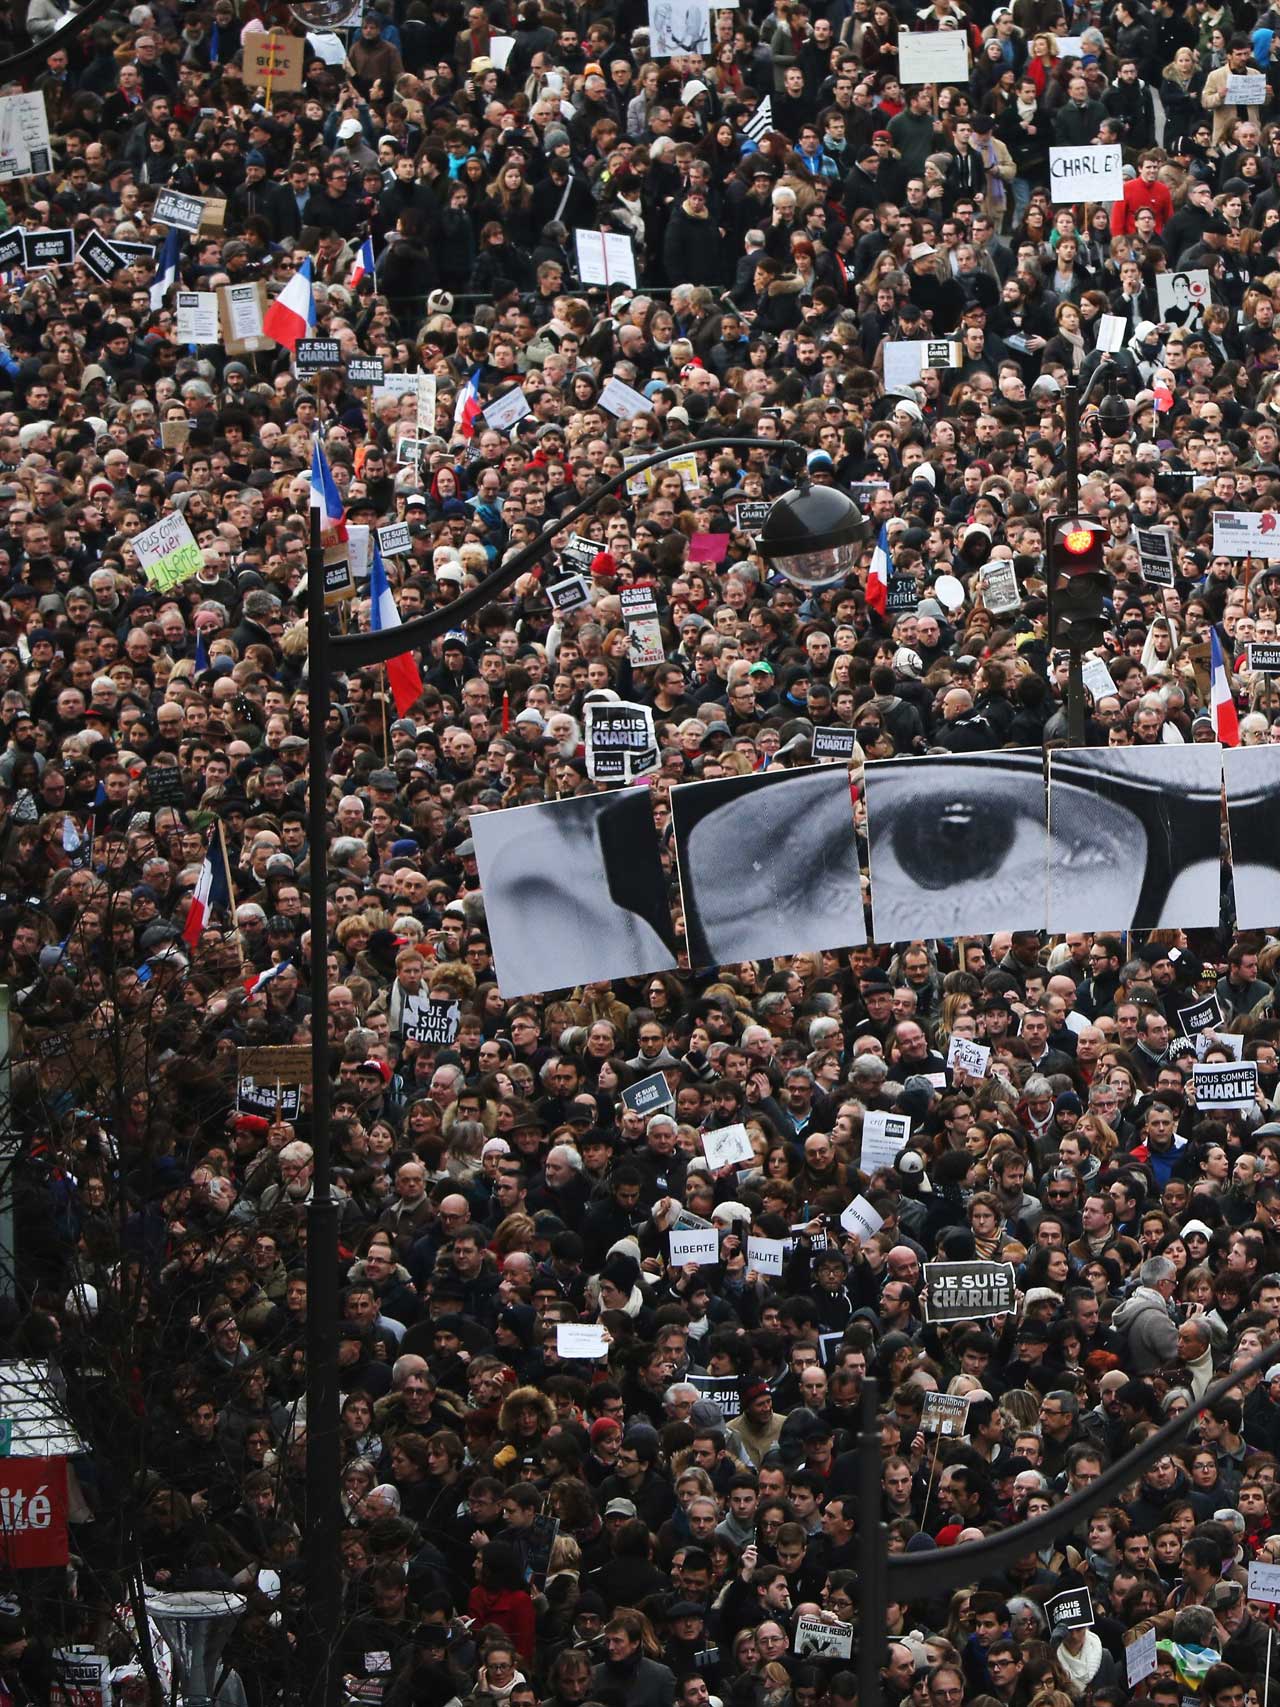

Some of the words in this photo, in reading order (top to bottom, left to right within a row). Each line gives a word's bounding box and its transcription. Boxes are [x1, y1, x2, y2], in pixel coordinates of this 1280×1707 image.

[161, 195, 176, 207] JE
[176, 199, 201, 213] SUIS
[157, 204, 200, 225] CHARLIE
[299, 343, 313, 351] JE
[313, 342, 338, 351] SUIS
[298, 350, 340, 362] CHARLIE
[348, 360, 361, 369] JE
[362, 360, 383, 370] SUIS
[348, 368, 383, 381] CHARLIE
[382, 533, 389, 541] JE
[391, 528, 407, 538] SUIS
[383, 534, 411, 550] CHARLIE
[629, 586, 651, 594] SUIS
[620, 593, 653, 604] CHARLIE
[592, 720, 610, 731] JE
[612, 719, 646, 730] SUIS
[592, 730, 647, 747] CHARLIE
[815, 739, 853, 751] CHARLIE
[427, 1005, 443, 1017] JE
[1198, 1007, 1212, 1018] SUIS
[421, 1016, 448, 1030] SUIS
[1190, 1014, 1214, 1028] CHARLIE
[1195, 1073, 1219, 1084] NOUS
[1221, 1071, 1255, 1082] SOMMES
[642, 1084, 657, 1095] SUIS
[1196, 1081, 1256, 1100] CHARLIE
[673, 1242, 715, 1254] LIBERTE
[933, 1275, 959, 1289] JE
[961, 1272, 1008, 1288] SUIS
[932, 1287, 1010, 1308] CHARLIE
[713, 1391, 740, 1401] SUIS
[0, 1484, 52, 1531] ité
[1058, 1600, 1081, 1611] SUIS
[800, 1622, 829, 1634] CHARLIE
[829, 1626, 852, 1638] HEBDO
